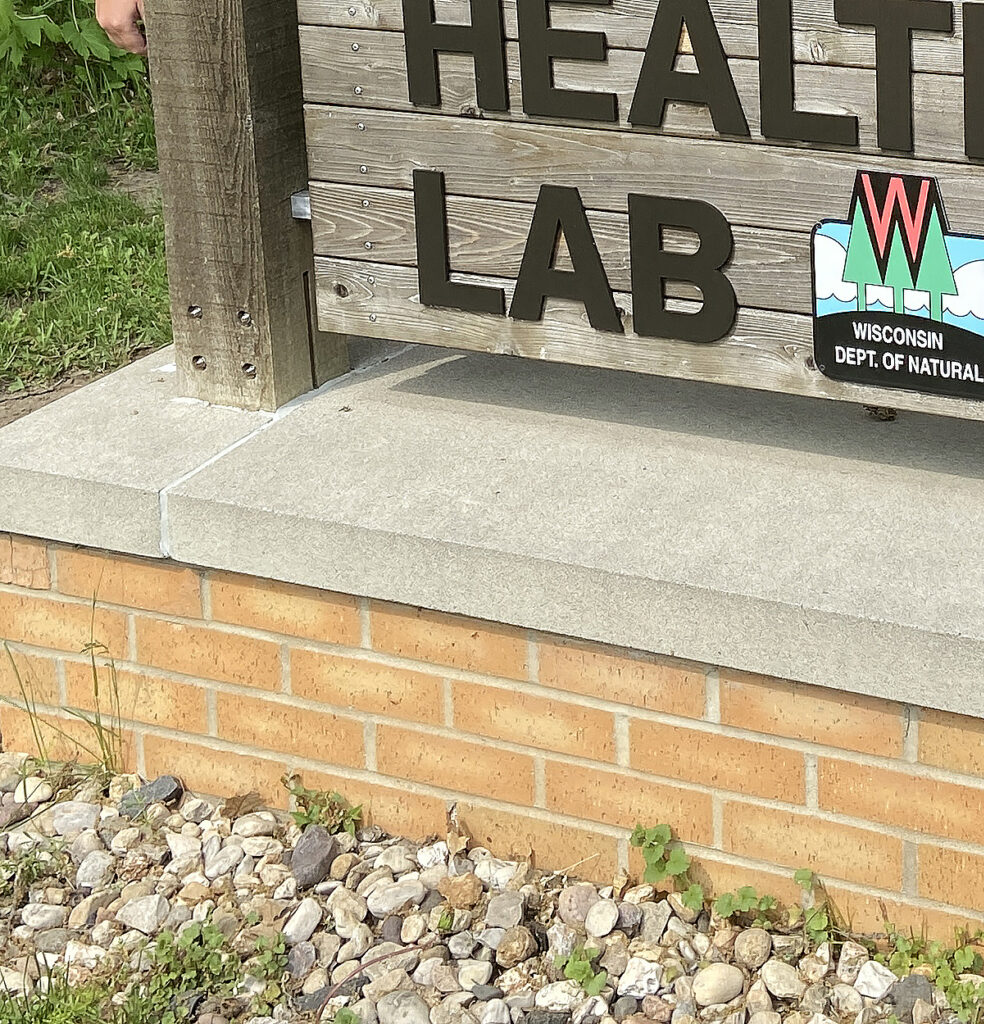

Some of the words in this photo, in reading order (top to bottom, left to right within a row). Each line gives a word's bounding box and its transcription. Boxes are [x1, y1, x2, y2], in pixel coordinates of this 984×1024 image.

[412, 169, 739, 344] LAB
[853, 322, 943, 350] WISCONSIN
[835, 345, 879, 369] DEPT.
[882, 354, 904, 373] OF
[909, 358, 984, 383] NATURAL
